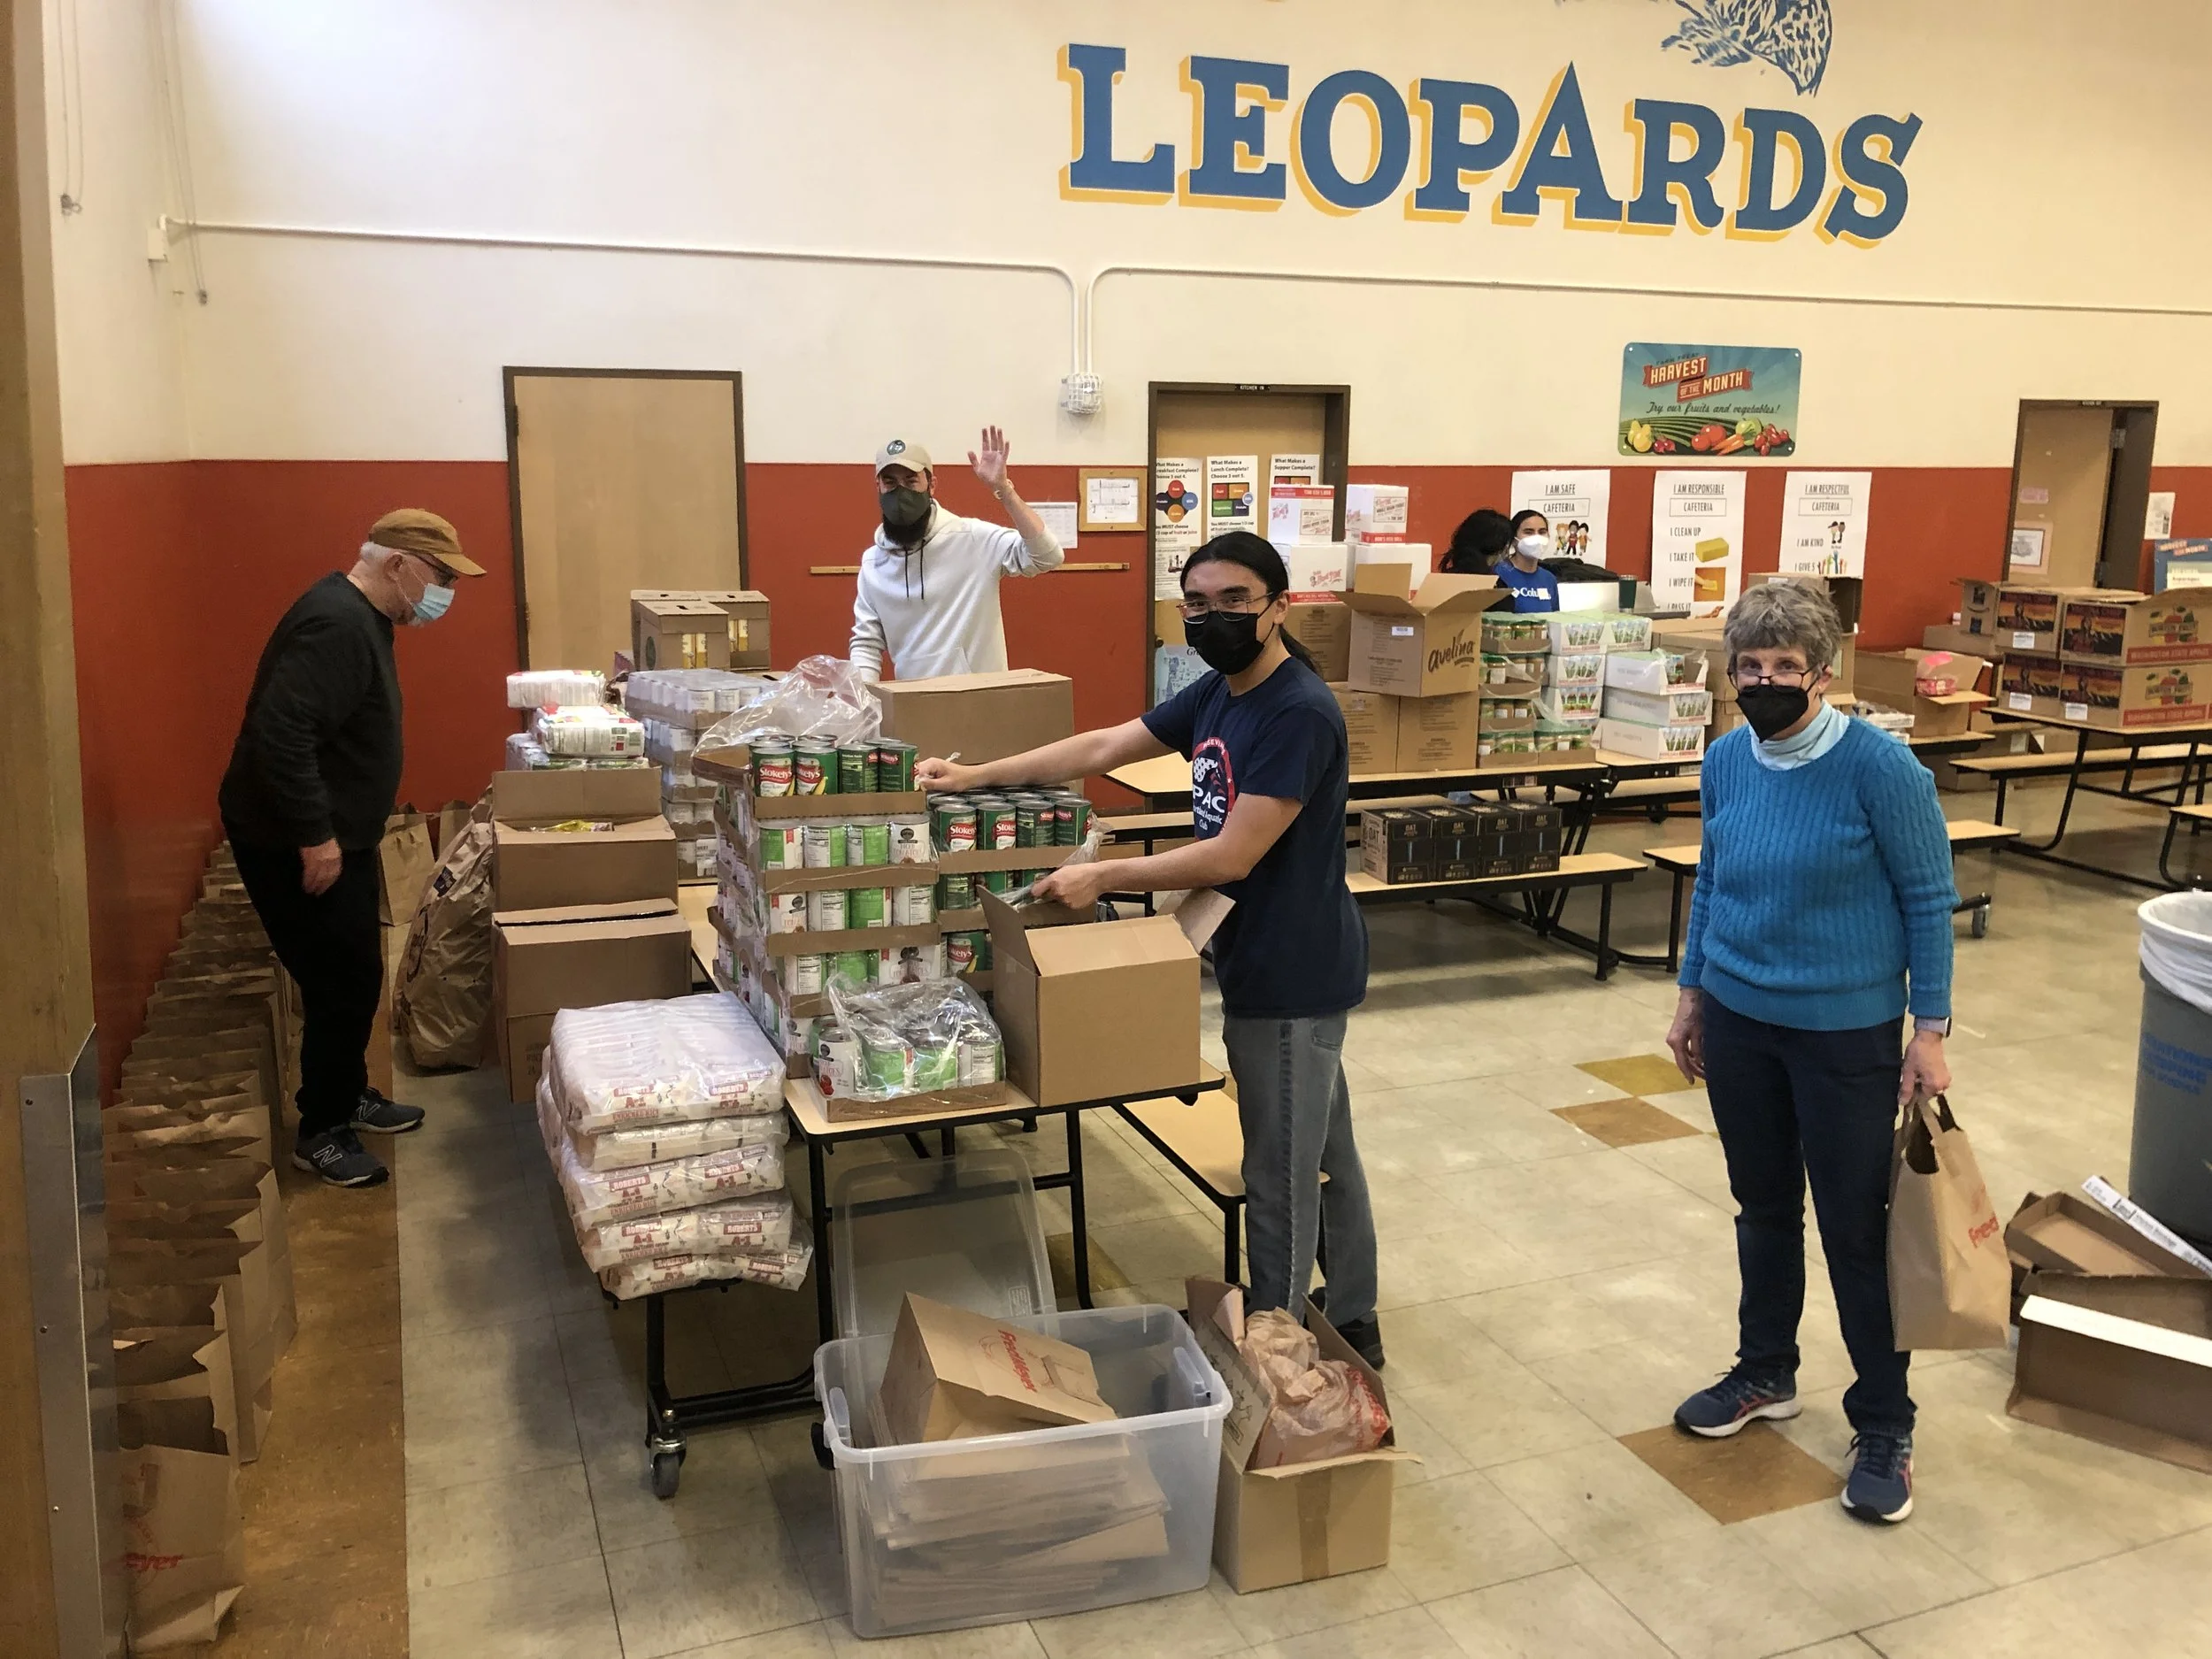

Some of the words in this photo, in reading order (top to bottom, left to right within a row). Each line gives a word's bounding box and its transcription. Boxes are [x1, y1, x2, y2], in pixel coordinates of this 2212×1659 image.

[1057, 42, 1923, 249] LEOPARDS
[1650, 357, 1707, 384] HARVEST
[1680, 388, 1689, 396] OF
[1689, 386, 1700, 395] THE
[1702, 371, 1743, 395] MONTH
[1647, 401, 1663, 414] Try
[1666, 404, 1681, 413] our
[1684, 403, 1709, 415] fruits
[1713, 403, 1730, 413] and
[1732, 403, 1780, 416] vegetables!
[1550, 485, 1560, 494] AM
[1561, 484, 1576, 494] SAFE
[1678, 485, 1686, 494] AM
[1688, 484, 1724, 495] RESPONSIBLE
[1809, 485, 1817, 494] AM
[1818, 484, 1849, 495] RESPECTFUL
[1543, 503, 1575, 513] CAFETERIA
[1683, 502, 1713, 512] CAFETERIA
[1811, 502, 1839, 511] CAFETERIA
[1674, 527, 1692, 537] CLEAN
[1694, 527, 1701, 536] UP
[1801, 538, 1809, 548] AM
[1810, 538, 1824, 548] KIND
[1673, 552, 1688, 562] TAKE
[1688, 552, 1694, 562] IT
[1798, 562, 1810, 572] GIVE
[1673, 578, 1687, 588] WIPE
[1687, 578, 1694, 588] IT
[1519, 588, 1551, 600] Colu
[1428, 633, 1475, 672] avelina
[760, 766, 793, 780] Stokely's
[799, 766, 821, 780] kely's
[1193, 784, 1226, 813] PAC
[996, 823, 1016, 832] Stoke
[1199, 818, 1209, 831] Club
[950, 947, 972, 957] kely's
[613, 1177, 647, 1189] ROBERTS
[727, 1225, 758, 1233] ROBERTS
[126, 1553, 184, 1574] eyer
